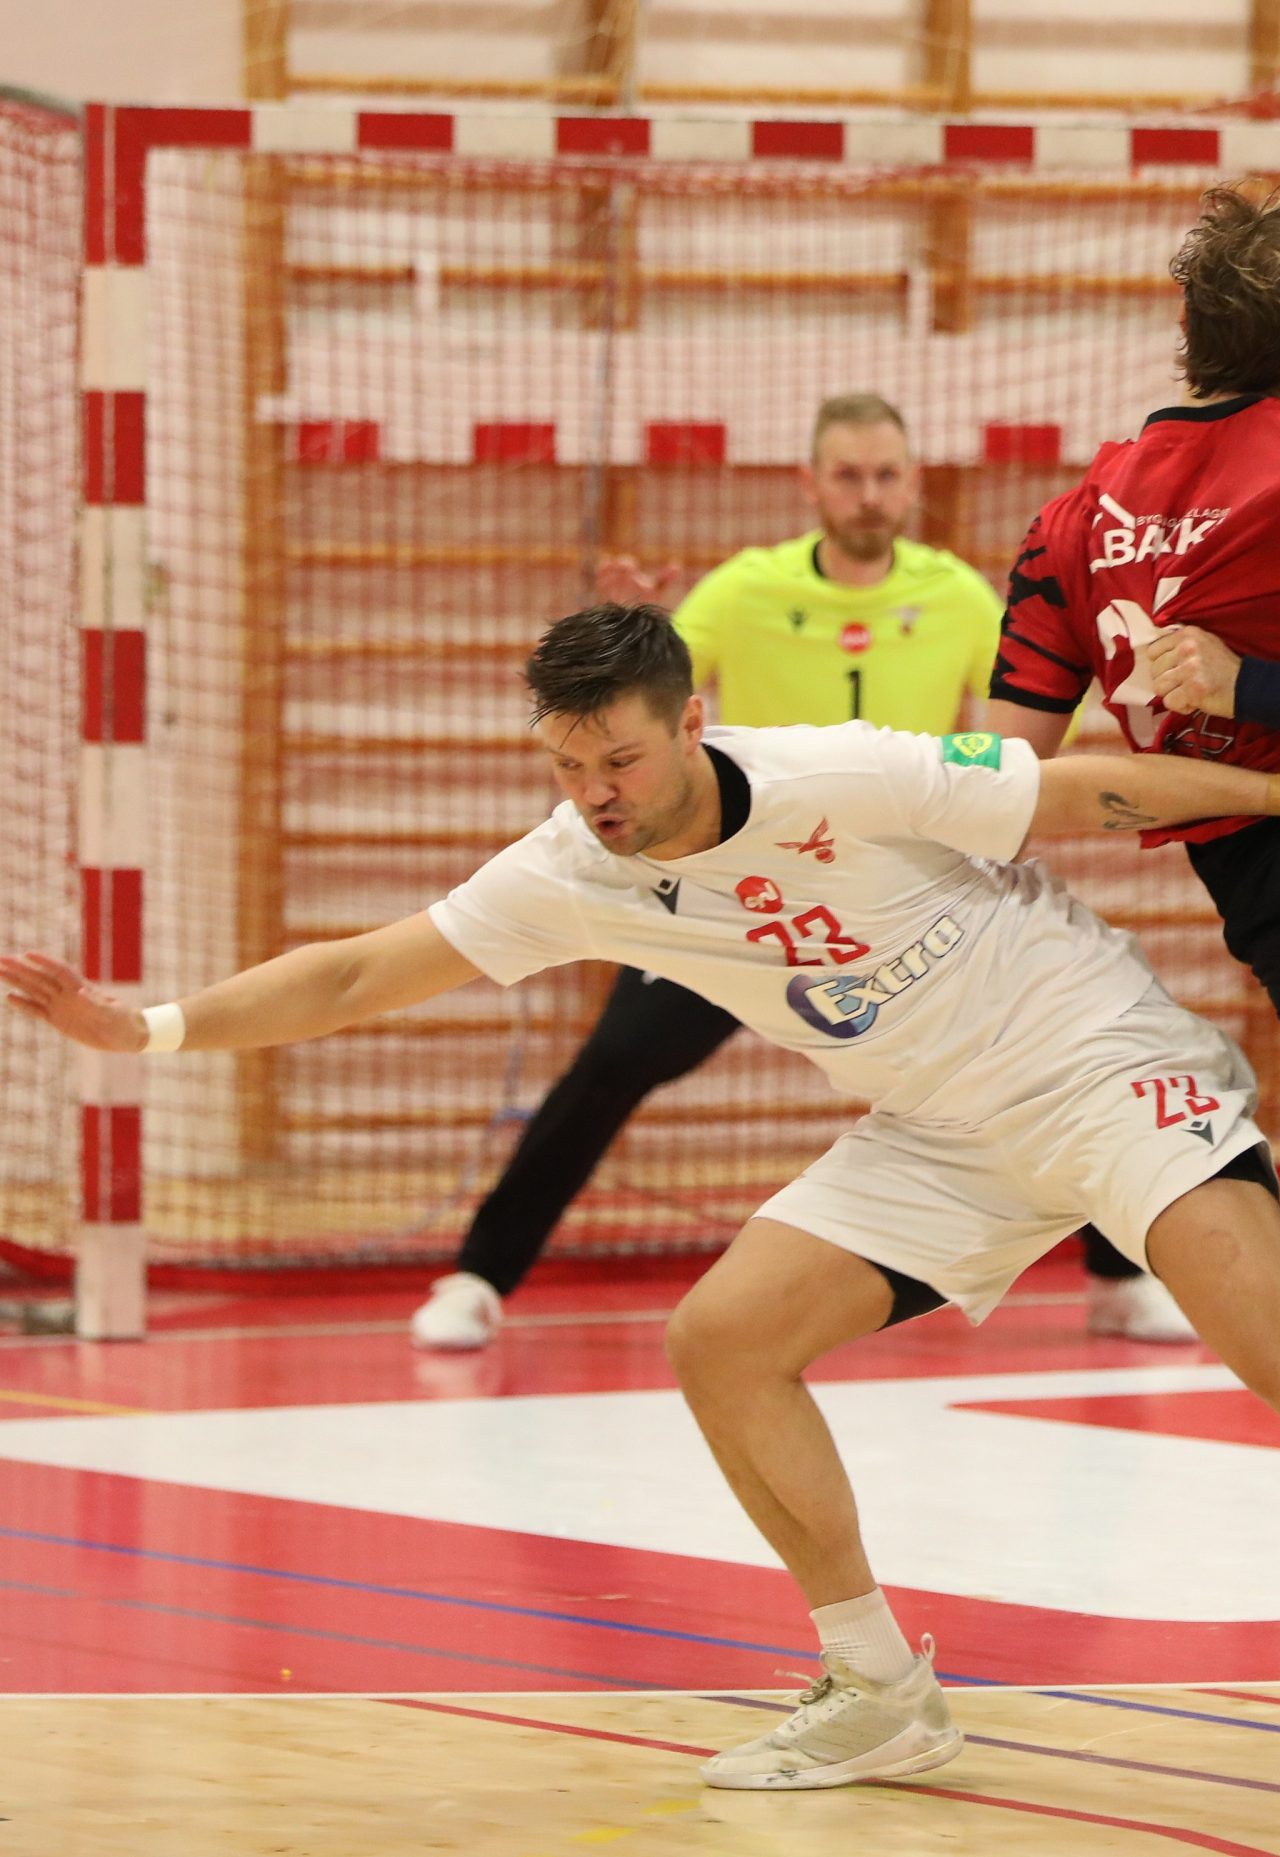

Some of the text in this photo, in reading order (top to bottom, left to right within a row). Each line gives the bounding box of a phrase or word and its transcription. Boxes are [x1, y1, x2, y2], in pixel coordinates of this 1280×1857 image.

[746, 905, 870, 966] 23
[804, 914, 965, 1026] Extra
[1130, 1075, 1220, 1129] 23
